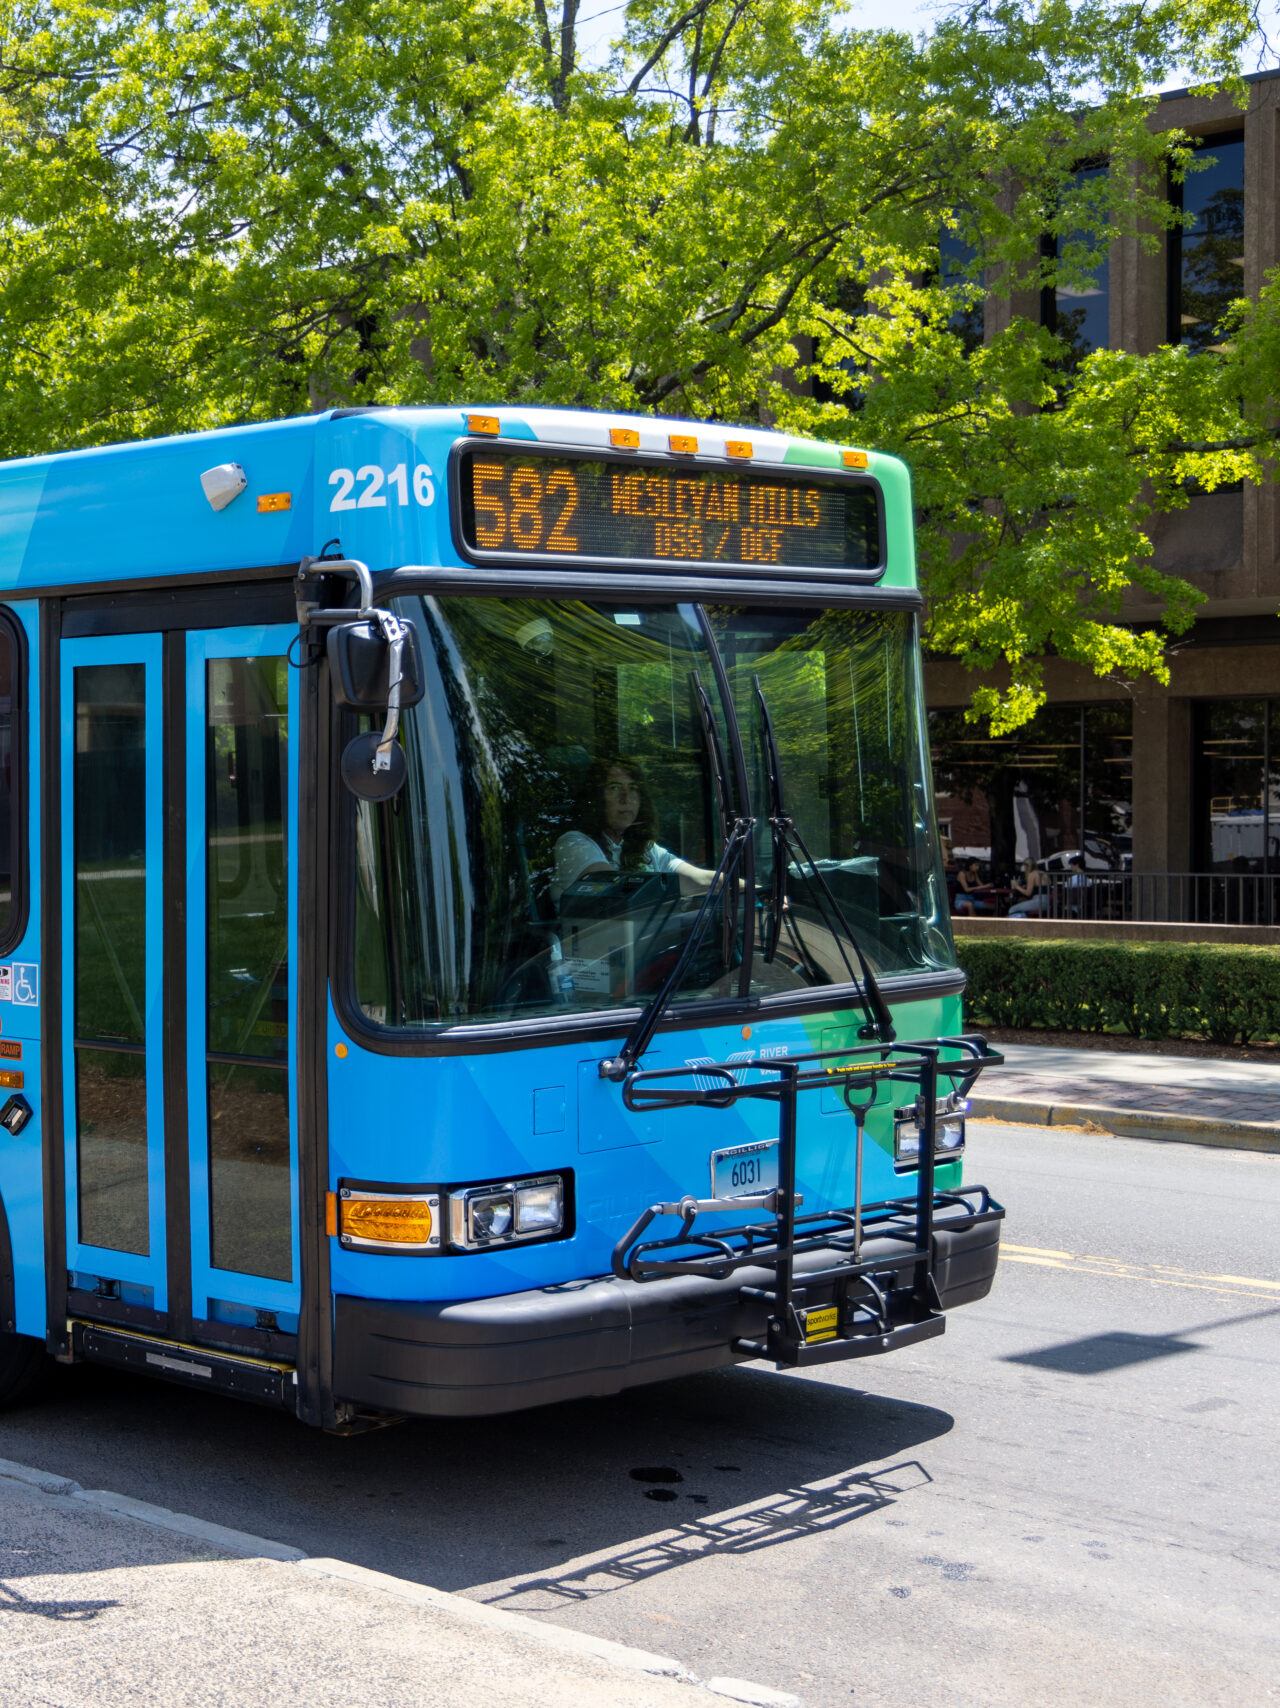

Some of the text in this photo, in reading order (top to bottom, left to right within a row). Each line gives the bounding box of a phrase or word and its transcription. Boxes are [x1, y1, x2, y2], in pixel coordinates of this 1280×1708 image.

[328, 463, 435, 512] 2216
[473, 464, 820, 551] 582 WESLEYAN HILLS
[655, 522, 703, 558] DSS
[1, 1043, 20, 1056] RAMP
[760, 1045, 788, 1060] RIVER
[730, 1143, 766, 1155] GILLIG
[731, 1157, 761, 1188] 6031
